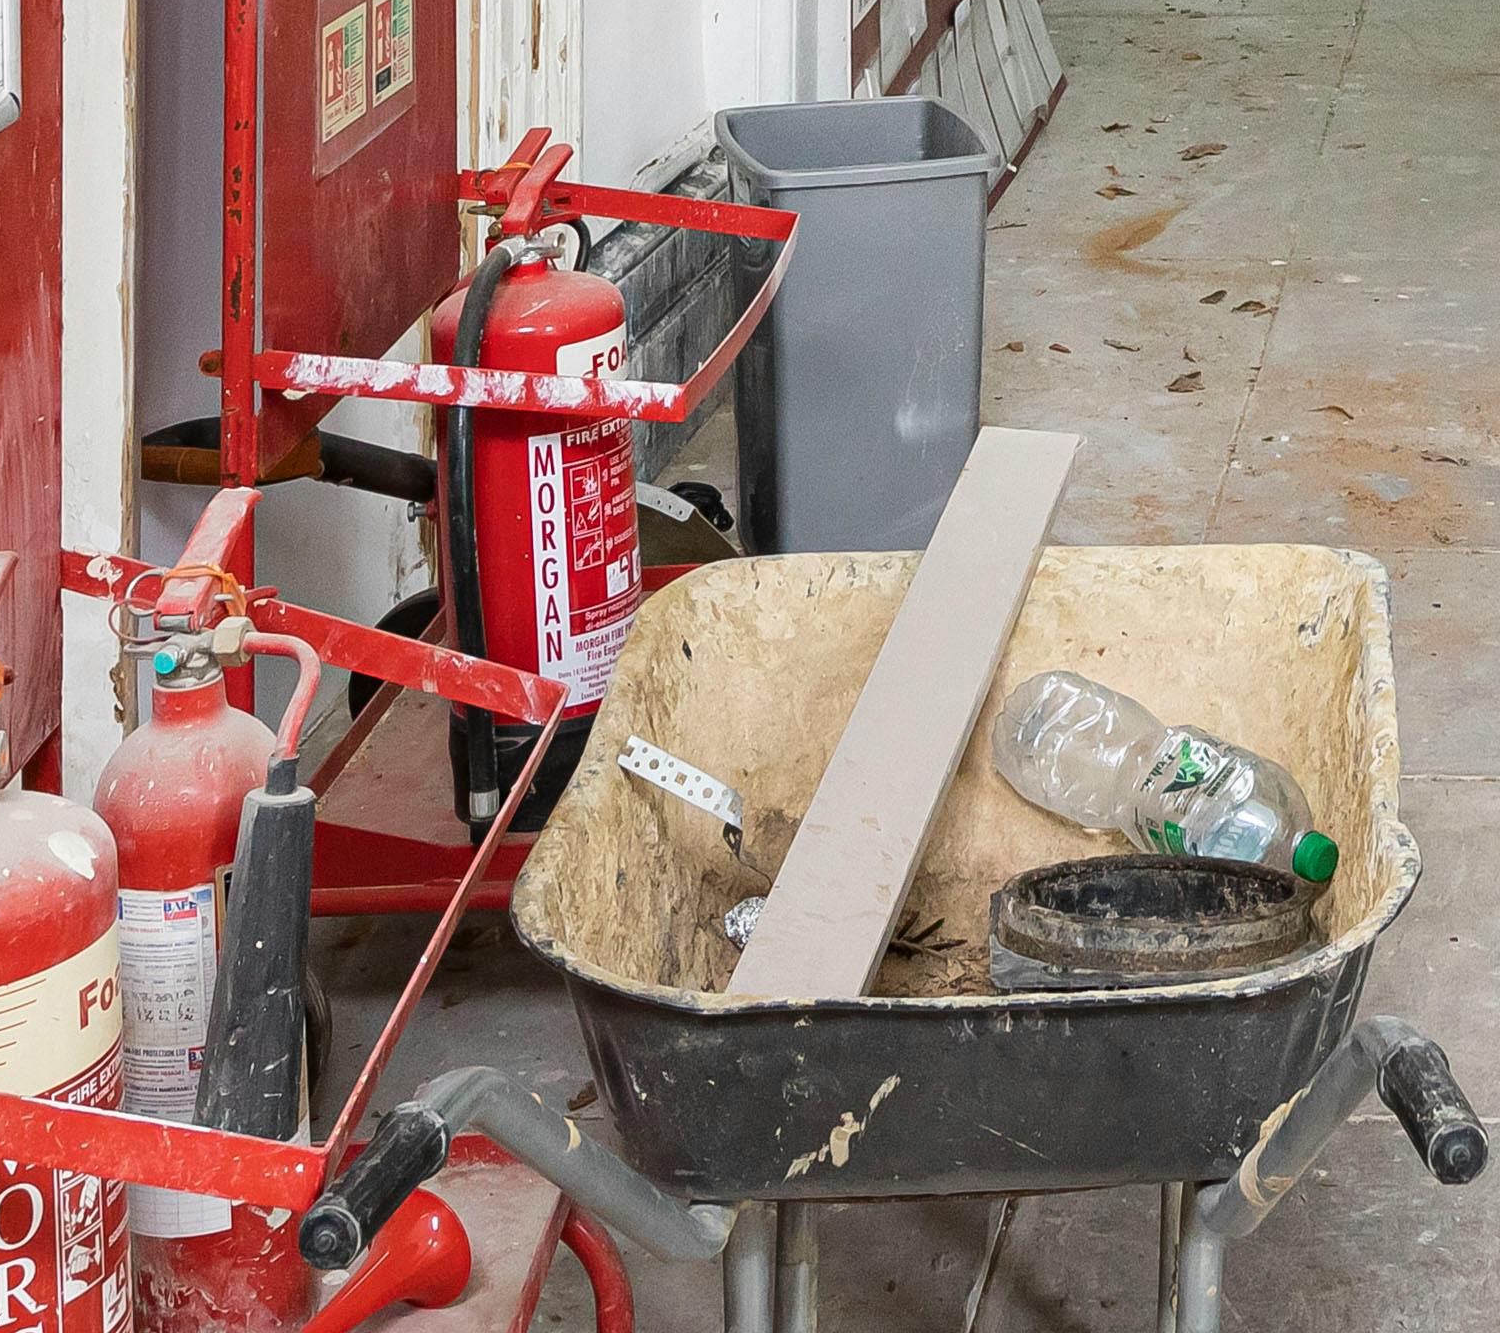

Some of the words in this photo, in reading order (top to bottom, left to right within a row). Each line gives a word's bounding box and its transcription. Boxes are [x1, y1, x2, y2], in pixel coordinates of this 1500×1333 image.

[566, 424, 599, 447] FIRE
[534, 444, 563, 663] MORGAN
[575, 630, 610, 653] MORGAN
[587, 648, 602, 661] Fire
[68, 1075, 98, 1105] FIRE
